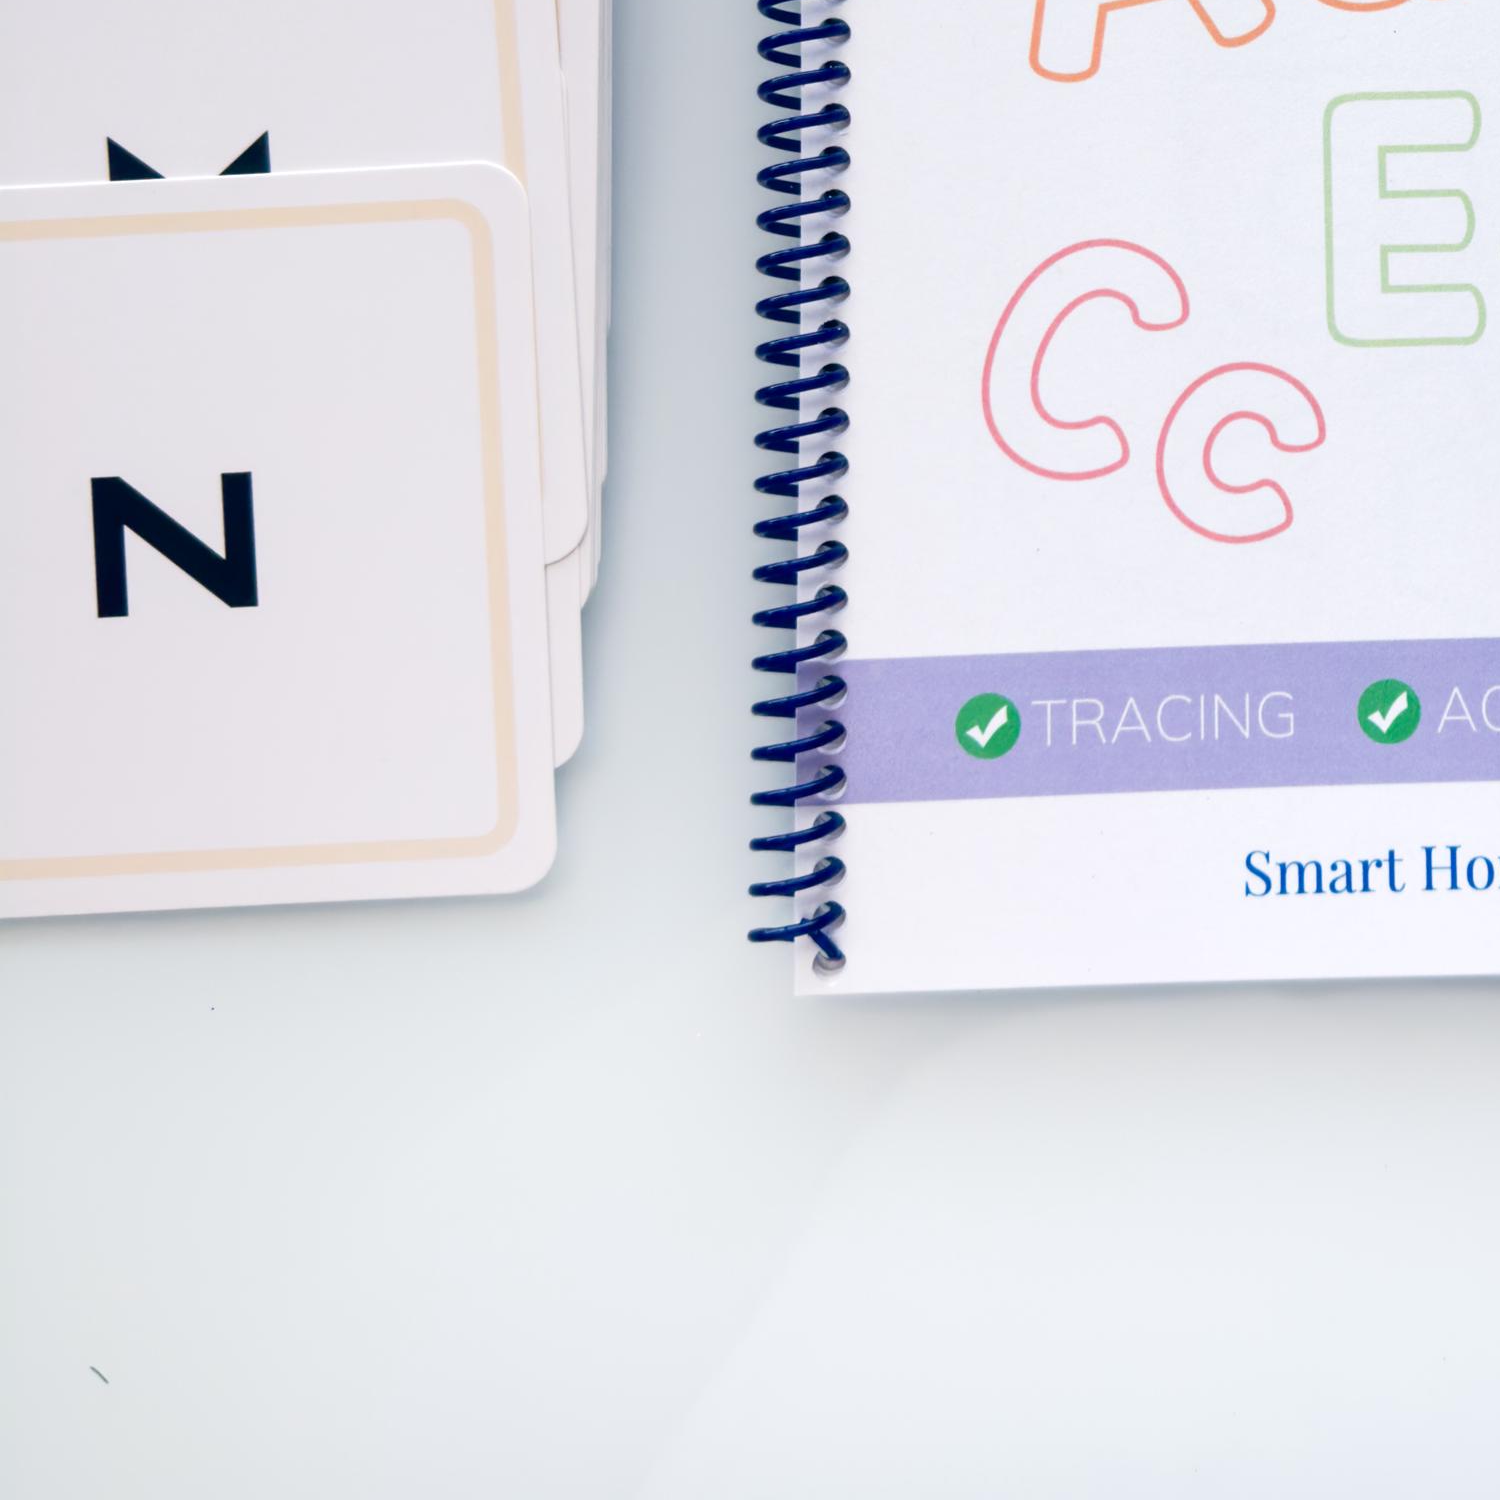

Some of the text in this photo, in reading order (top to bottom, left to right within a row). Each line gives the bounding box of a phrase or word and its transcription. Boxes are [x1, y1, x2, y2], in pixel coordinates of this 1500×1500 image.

[981, 238, 1326, 544] Cc
[90, 471, 259, 619] N
[1031, 691, 1297, 747] TRACING
[1244, 849, 1405, 897] Smart
